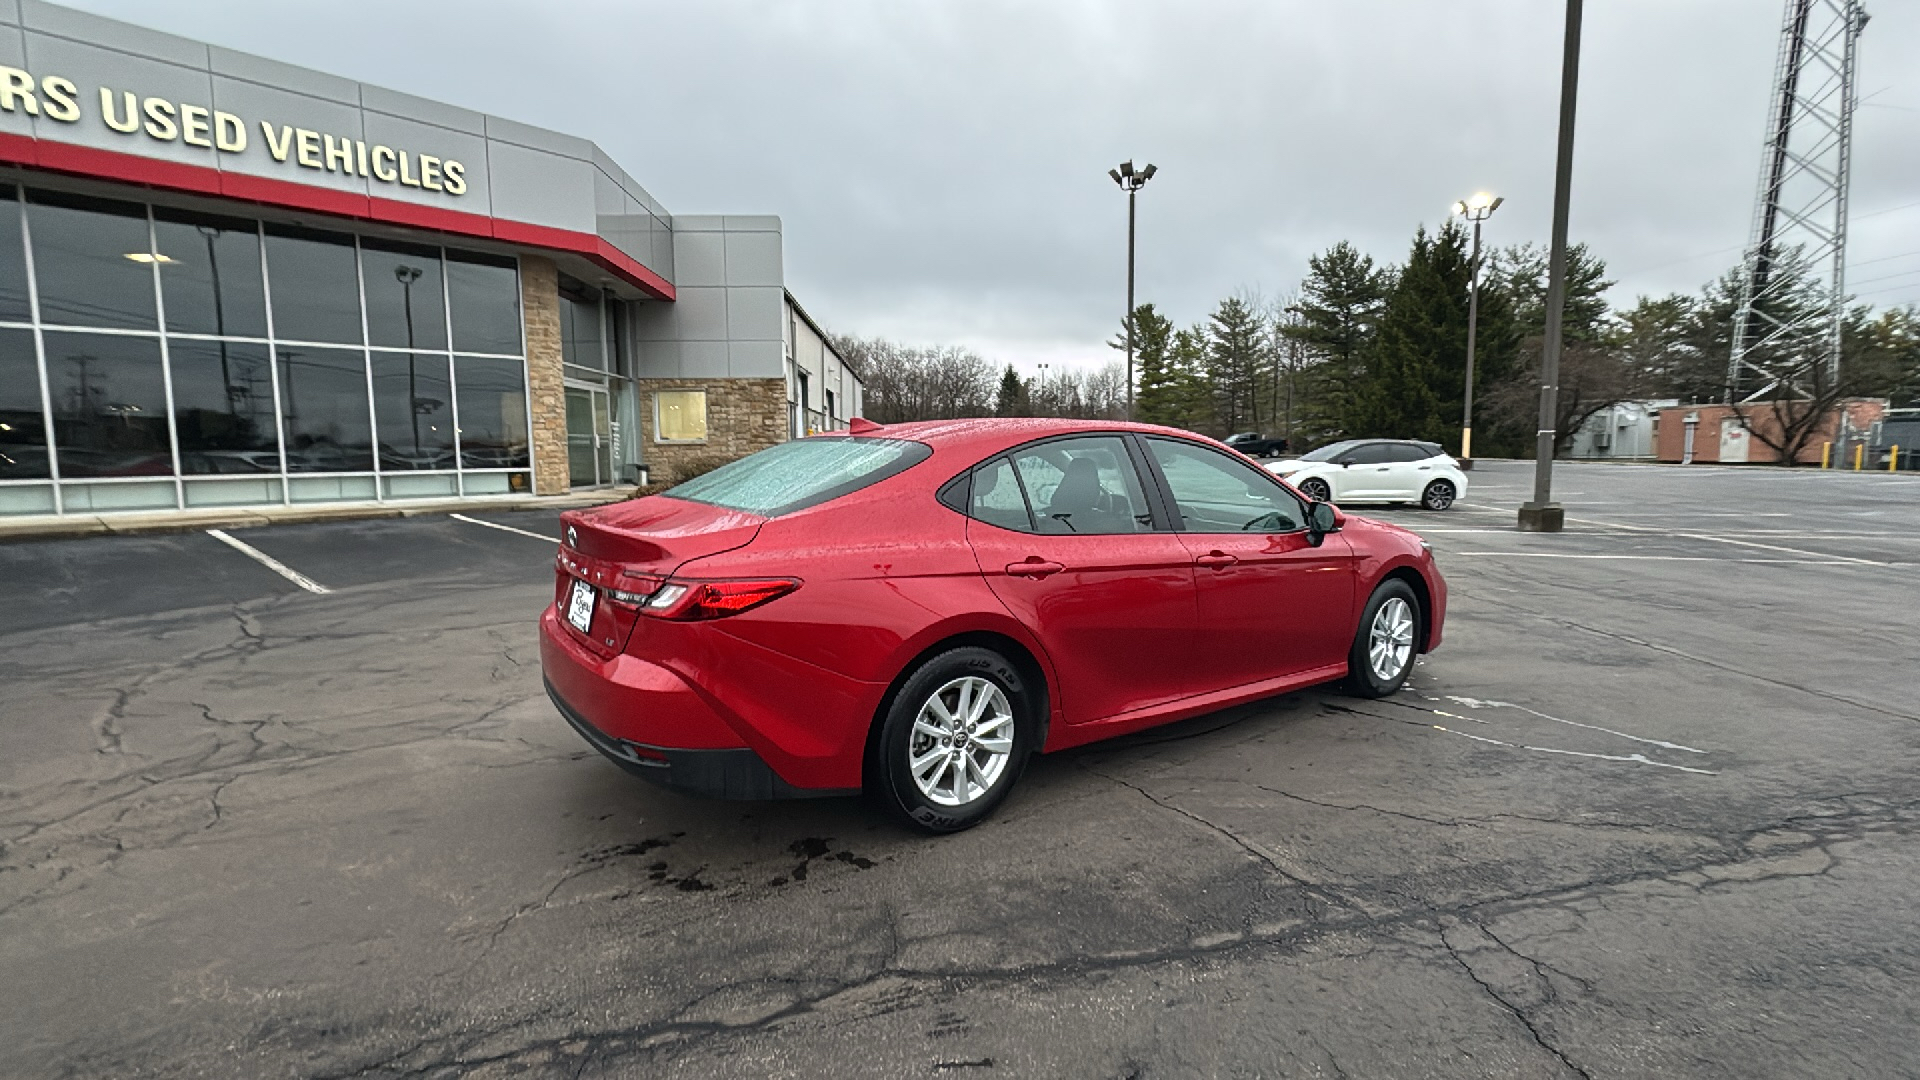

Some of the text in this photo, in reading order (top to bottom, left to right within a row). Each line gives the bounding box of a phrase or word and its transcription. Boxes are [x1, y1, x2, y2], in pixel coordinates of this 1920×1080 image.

[0, 65, 467, 196] RS USED VEHICLES
